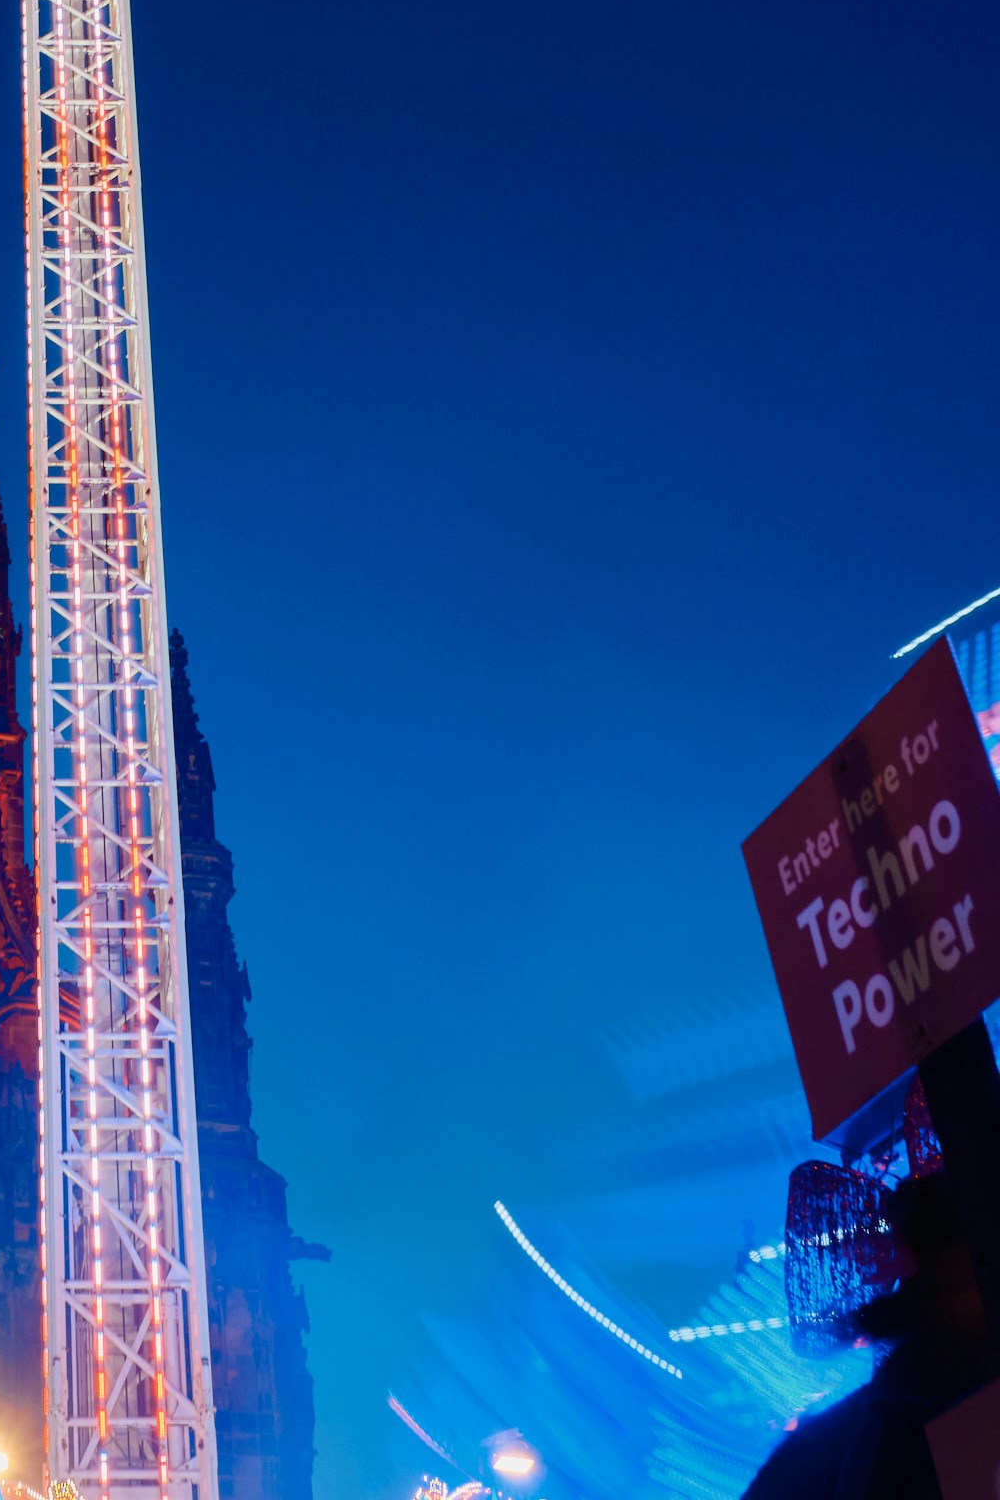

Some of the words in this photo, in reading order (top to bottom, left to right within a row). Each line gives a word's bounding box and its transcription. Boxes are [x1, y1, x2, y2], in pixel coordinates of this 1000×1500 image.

[777, 817, 841, 896] Enter
[842, 762, 901, 834] here
[900, 719, 941, 778] for
[797, 799, 962, 969] Techno
[832, 893, 977, 1054] Power
